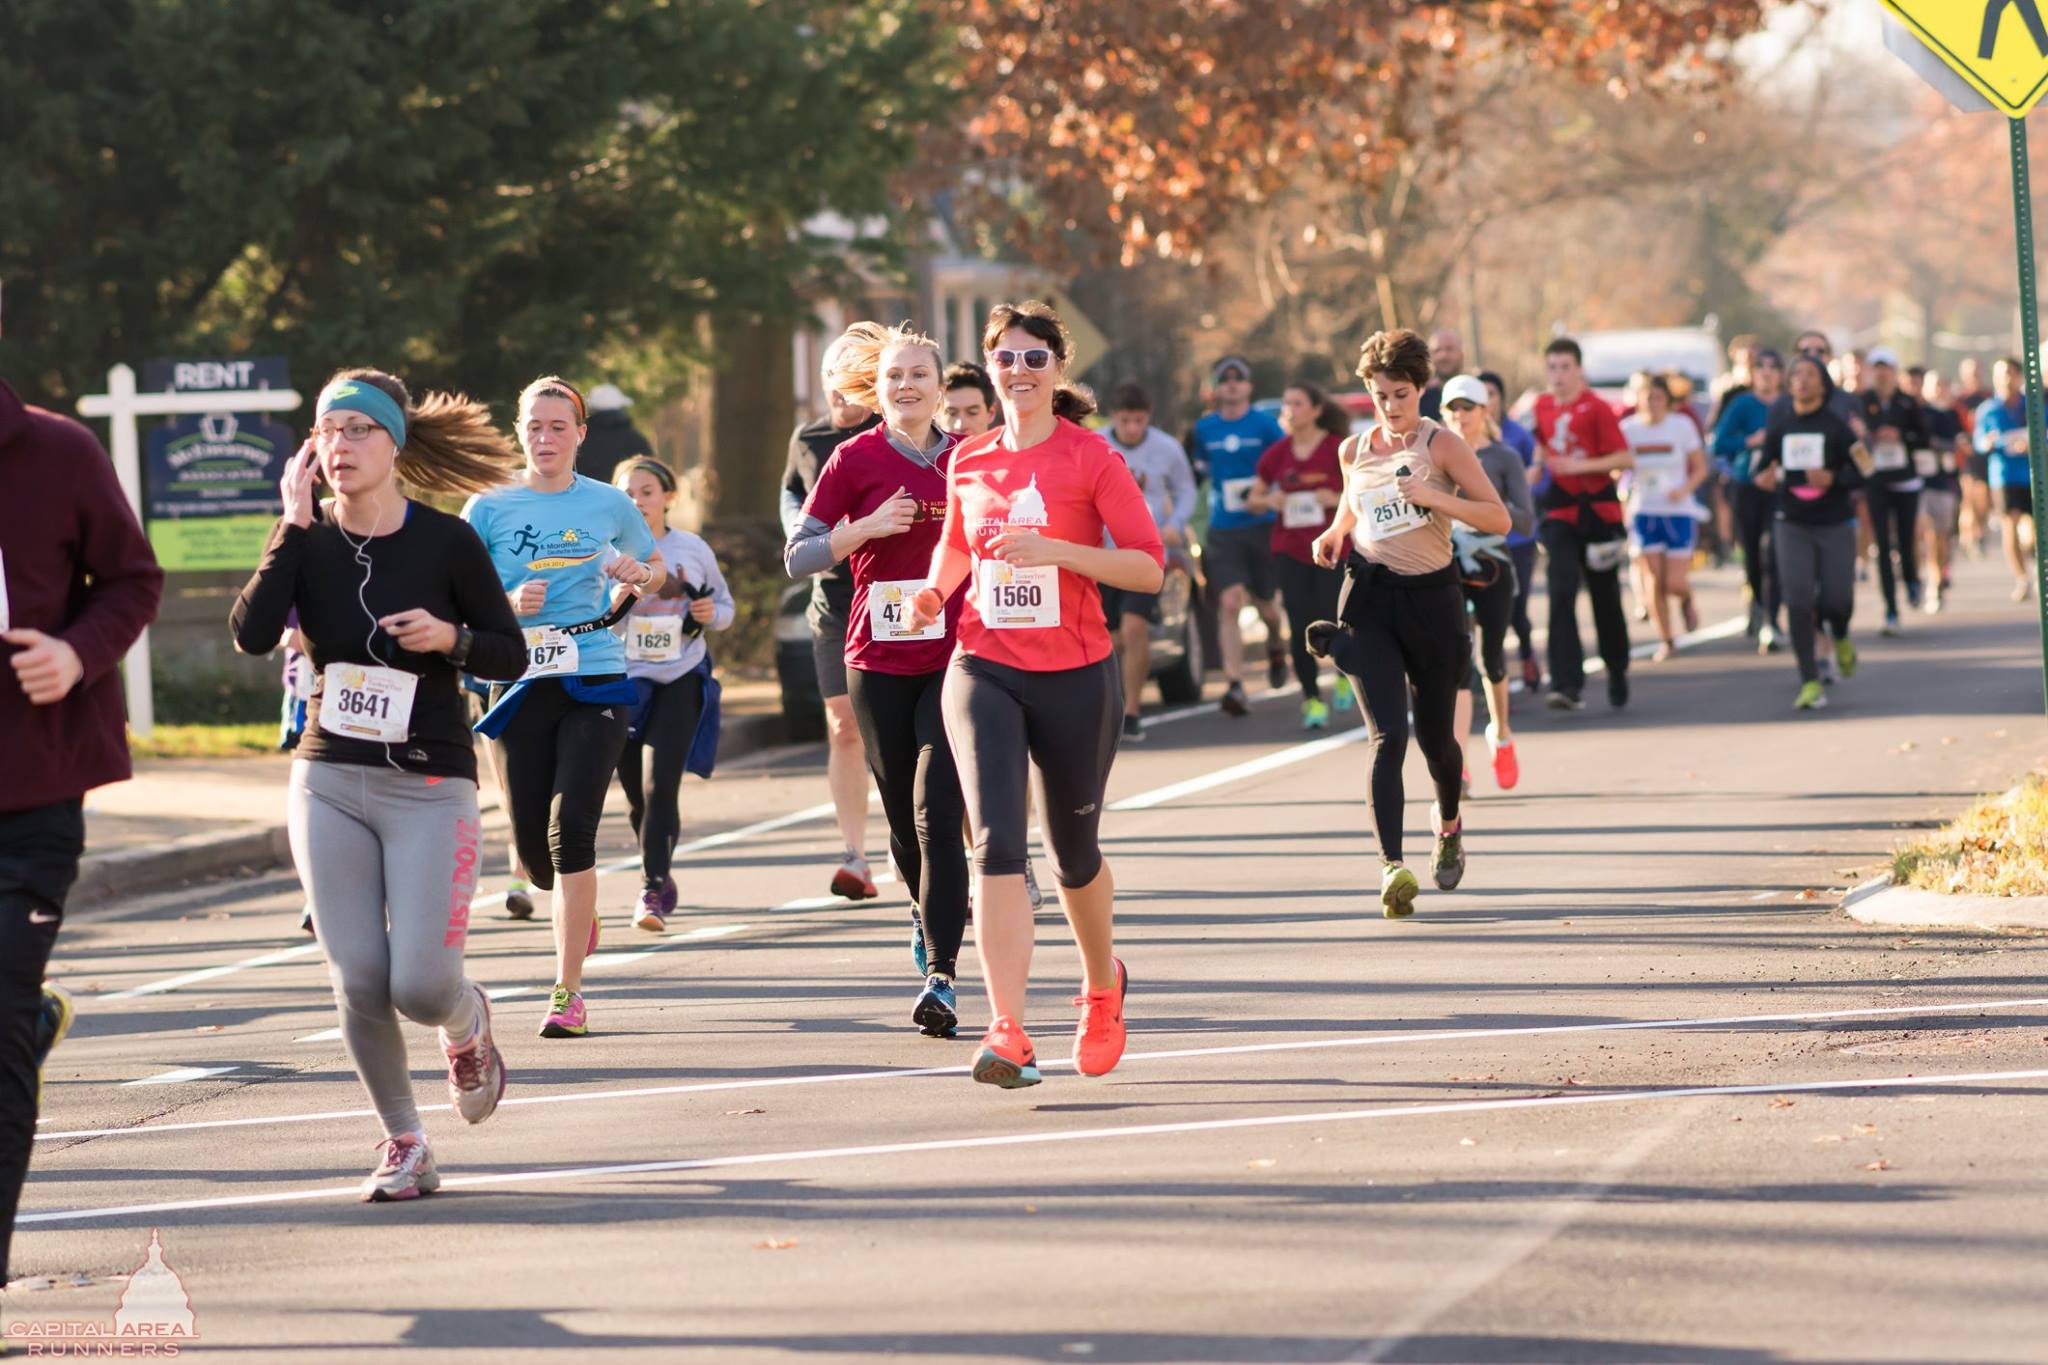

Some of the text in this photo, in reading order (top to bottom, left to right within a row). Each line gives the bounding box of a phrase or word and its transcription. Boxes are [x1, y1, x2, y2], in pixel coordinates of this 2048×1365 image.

[174, 361, 255, 389] RENT
[1010, 517, 1043, 525] AREA
[993, 585, 1042, 607] 1560
[883, 603, 902, 623] 47
[580, 623, 594, 633] TYR
[636, 633, 671, 648] 1629
[338, 688, 390, 719] 3641
